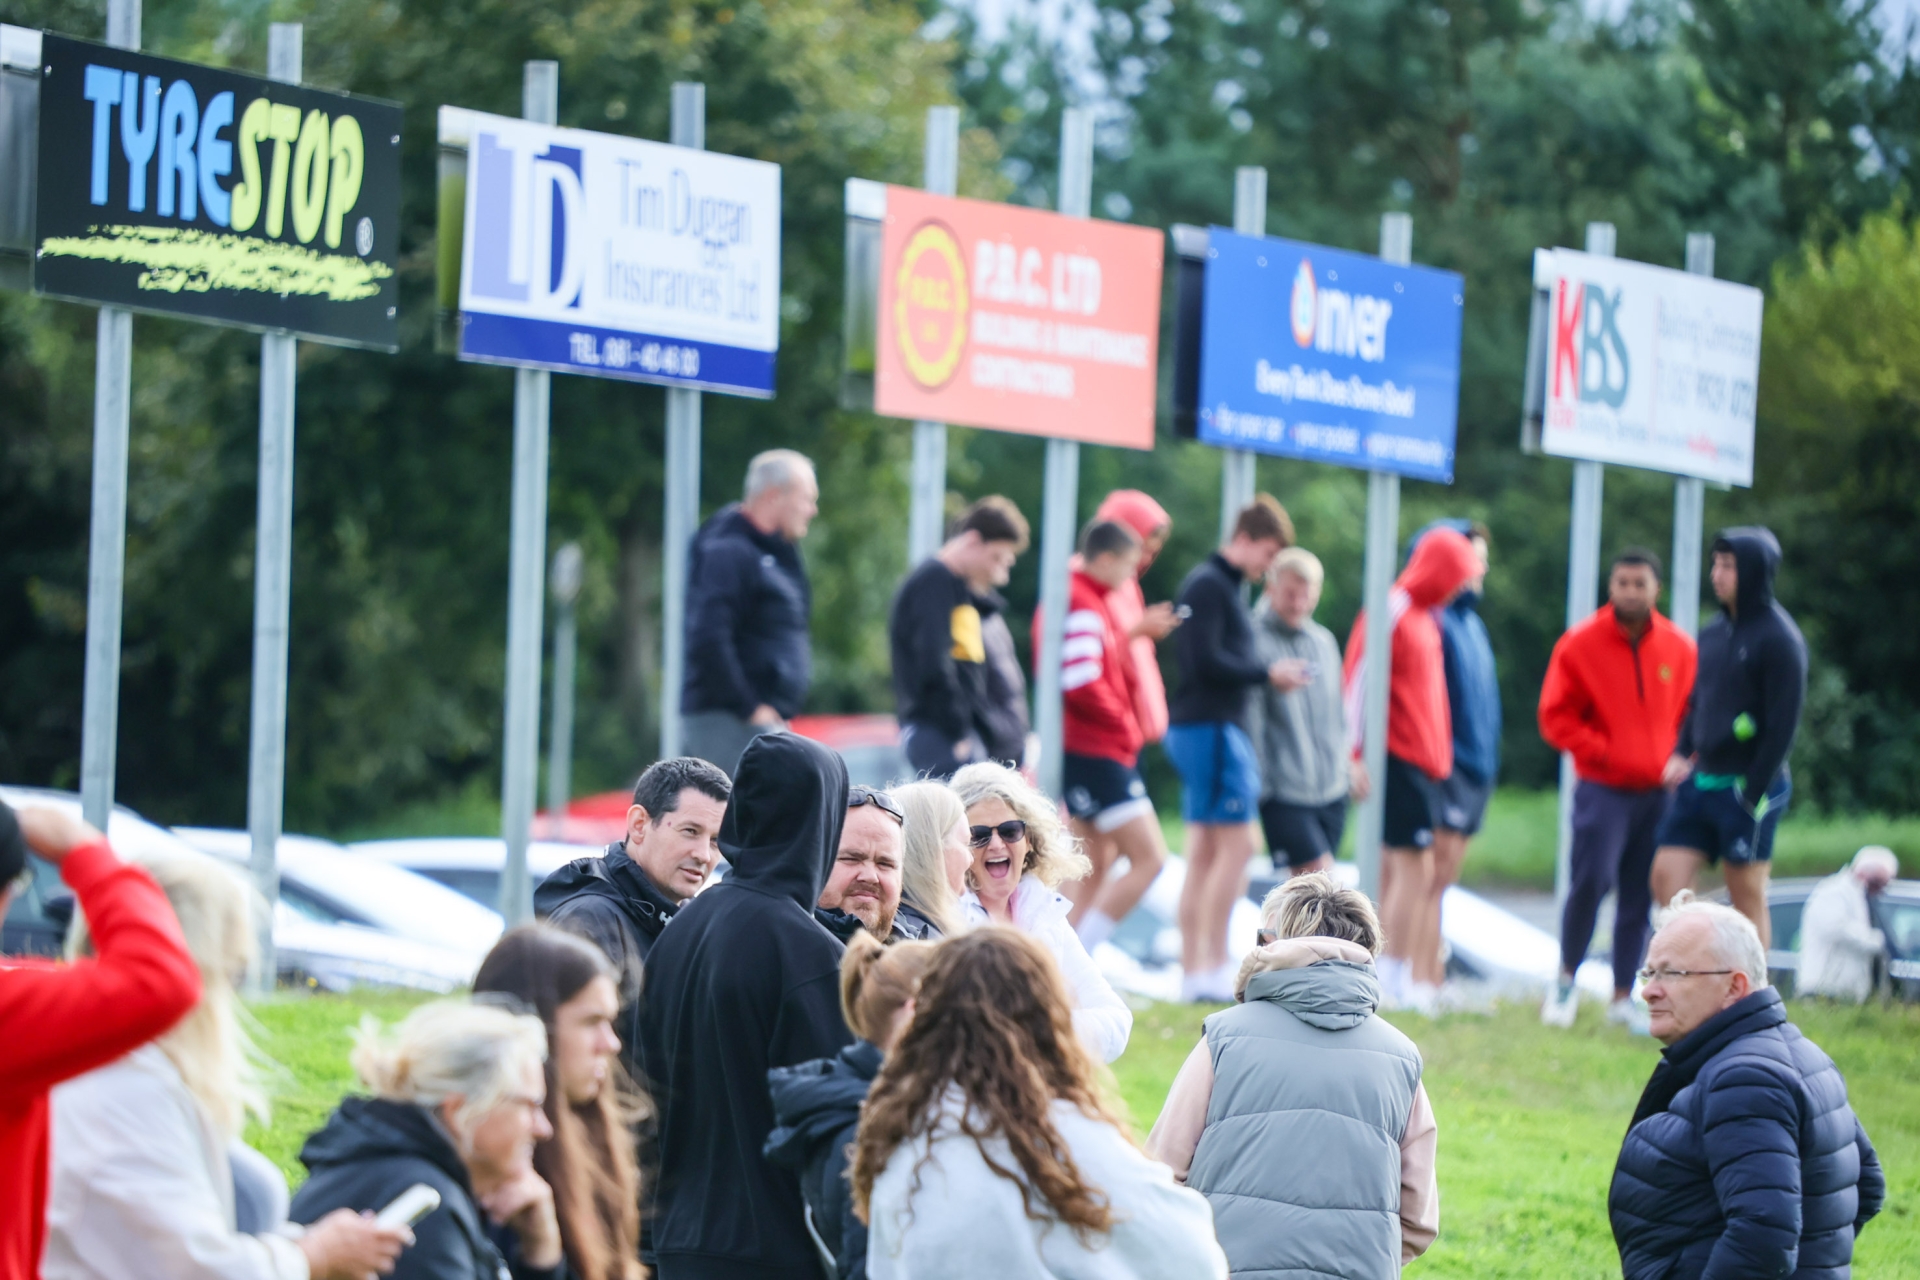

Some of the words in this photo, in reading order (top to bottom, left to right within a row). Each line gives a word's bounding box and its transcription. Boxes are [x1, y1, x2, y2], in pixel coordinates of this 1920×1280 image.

[667, 167, 752, 269] Duggan
[602, 237, 722, 314] Insurances
[1051, 251, 1102, 316] LTD
[1553, 276, 1630, 410] KBS
